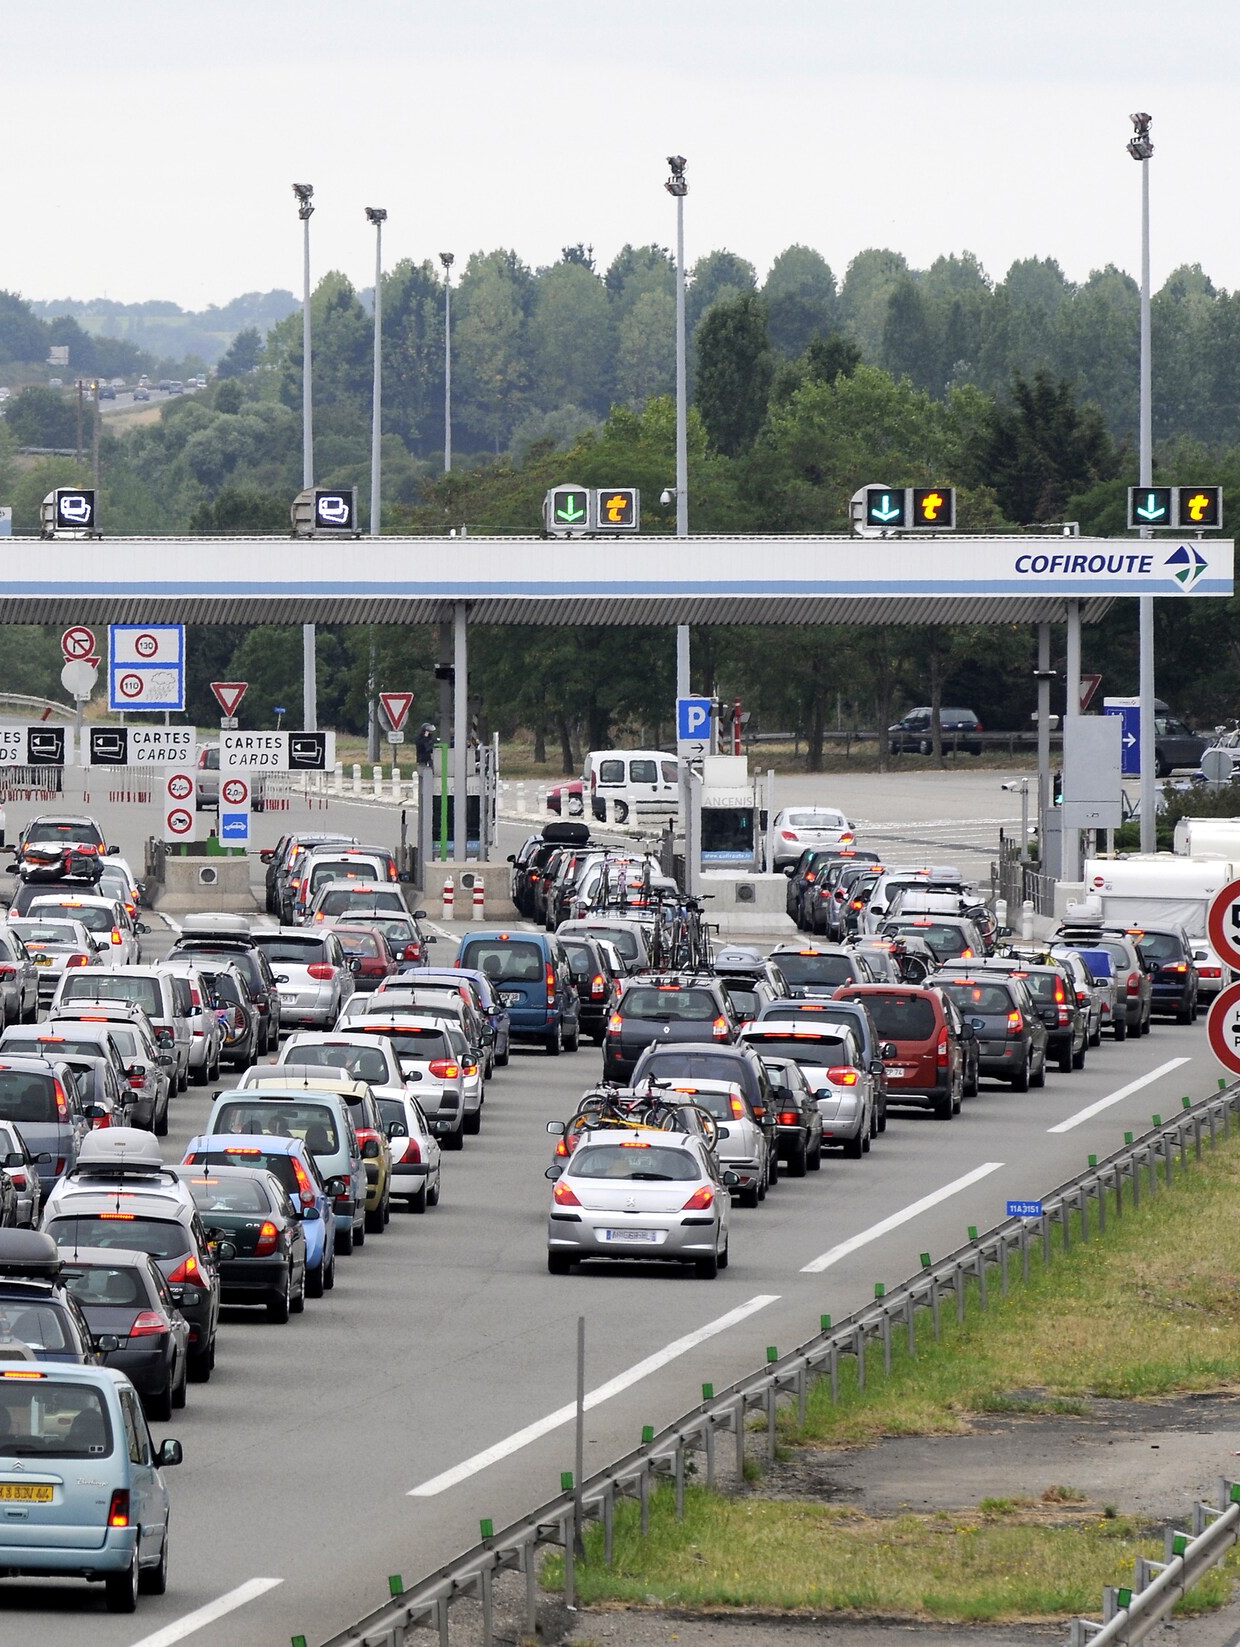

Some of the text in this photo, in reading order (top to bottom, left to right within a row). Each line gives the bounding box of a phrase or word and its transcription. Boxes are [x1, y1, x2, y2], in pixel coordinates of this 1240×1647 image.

[1015, 555, 1153, 573] COFIROUTE
[139, 642, 154, 650] 130
[124, 682, 139, 690] 110
[688, 706, 706, 733] P
[132, 732, 191, 744] CARTES
[225, 737, 282, 749] CARTES
[137, 748, 187, 760] CARDS
[229, 753, 280, 765] CARDS
[704, 797, 753, 807] ANCENIS
